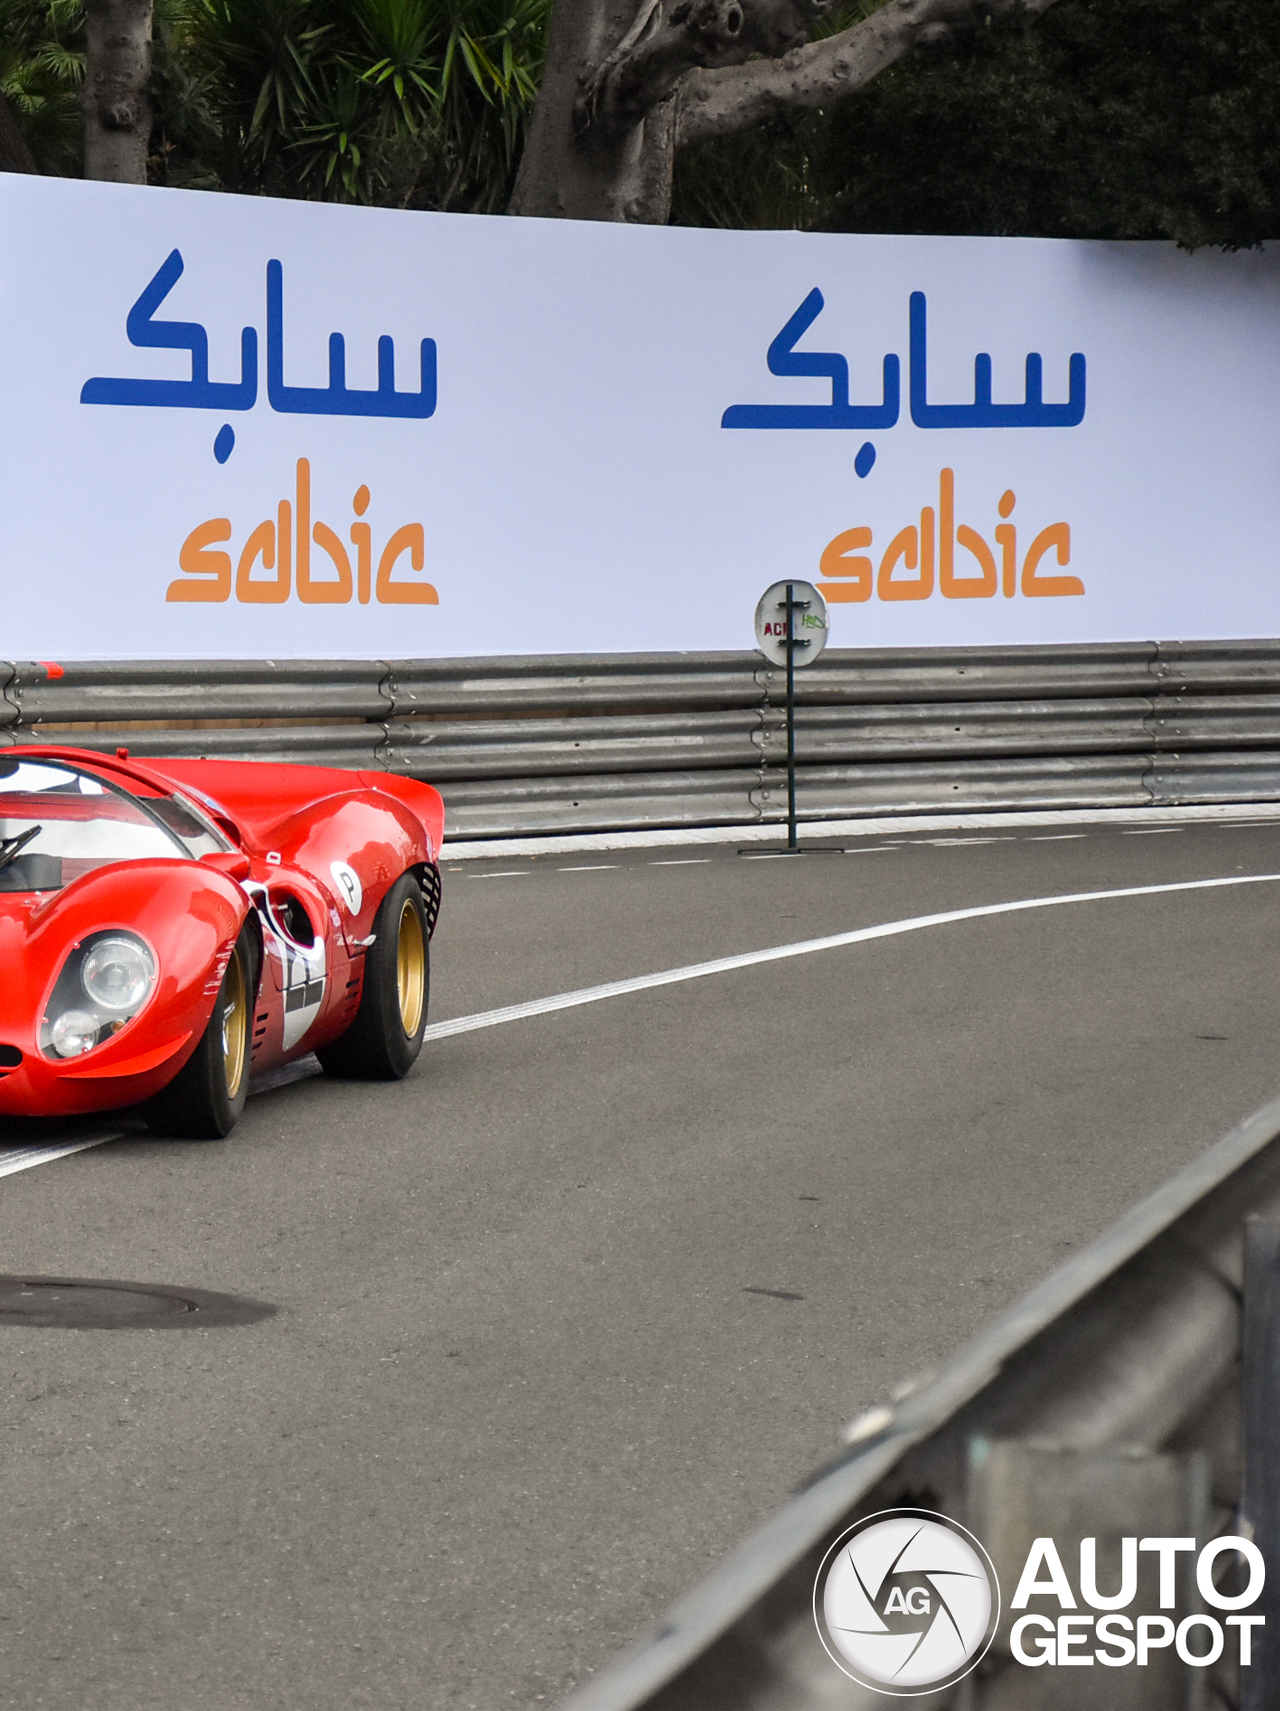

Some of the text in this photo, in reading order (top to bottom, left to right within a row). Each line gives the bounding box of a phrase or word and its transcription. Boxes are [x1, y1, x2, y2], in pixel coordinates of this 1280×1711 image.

[80, 248, 437, 464] سابك
[721, 287, 1086, 478] سابك
[166, 457, 440, 605] sabic
